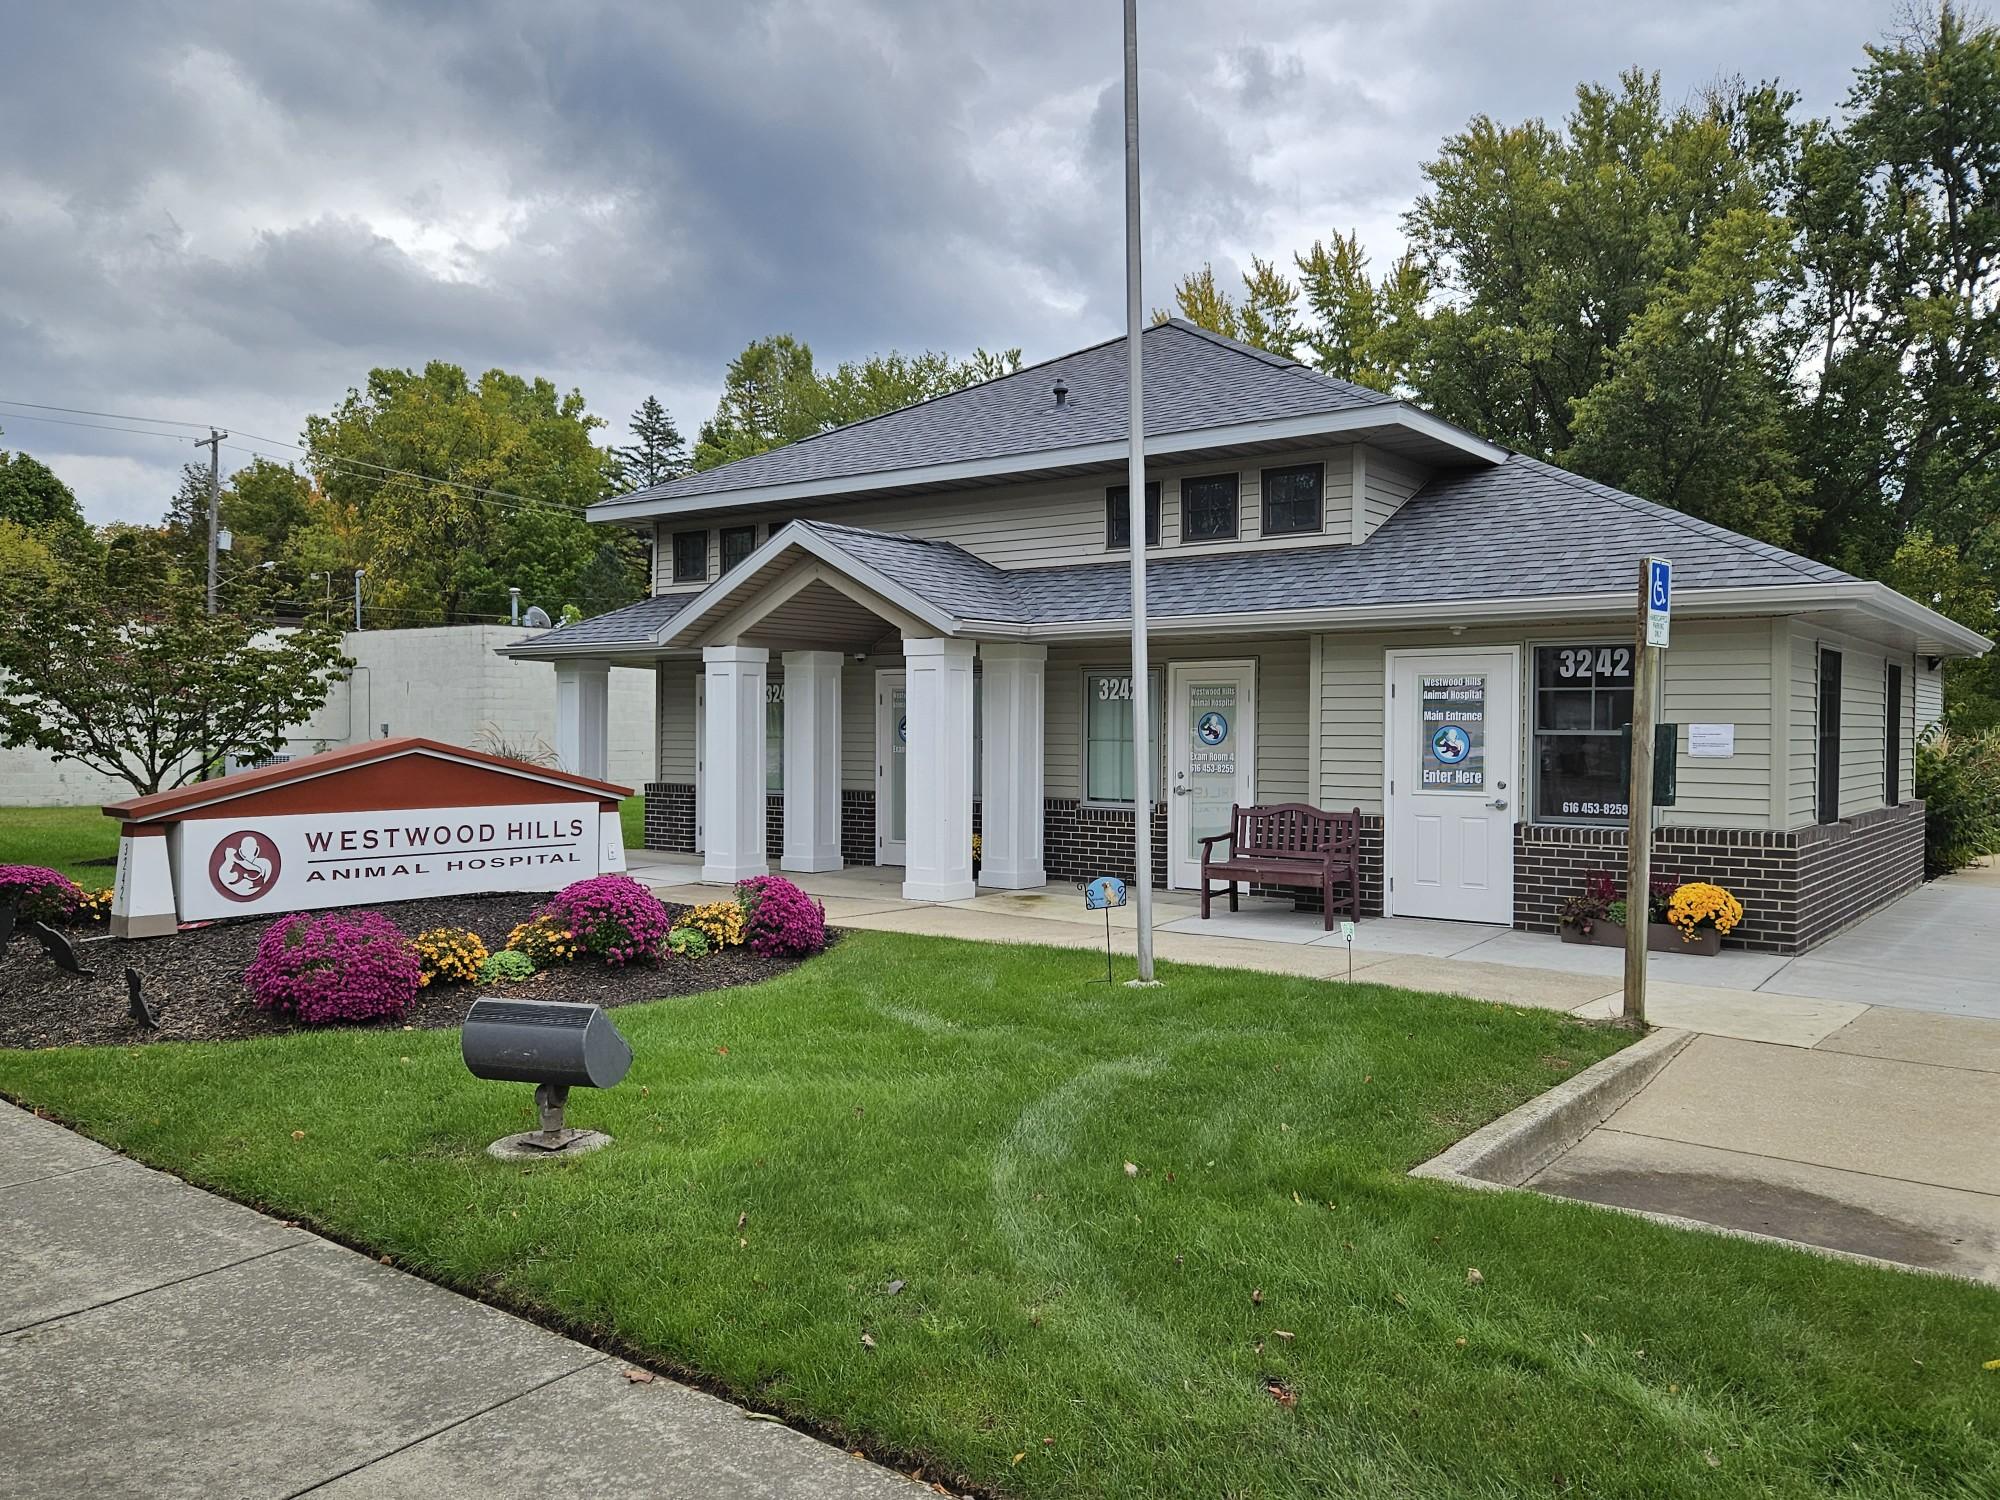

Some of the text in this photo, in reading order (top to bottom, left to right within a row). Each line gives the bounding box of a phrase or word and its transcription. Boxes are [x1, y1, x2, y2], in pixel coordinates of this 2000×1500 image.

[1559, 648, 1630, 677] 3242
[1424, 677, 1482, 687] Westwood Hills
[1191, 687, 1235, 697] Westwood Hills
[1423, 690, 1482, 701] Animal Hospital
[1191, 698, 1235, 708] Animal Hospital
[1424, 710, 1482, 721] Main Entrance
[1190, 752, 1235, 762] Exam Room 4
[1203, 763, 1234, 774] 453-8259
[1423, 769, 1482, 784] Enter Here
[1562, 802, 1629, 816] 616 453-8259
[305, 819, 583, 853] WESTWOOD HILLS
[306, 852, 581, 882] ANIMAL HOSPITAL
